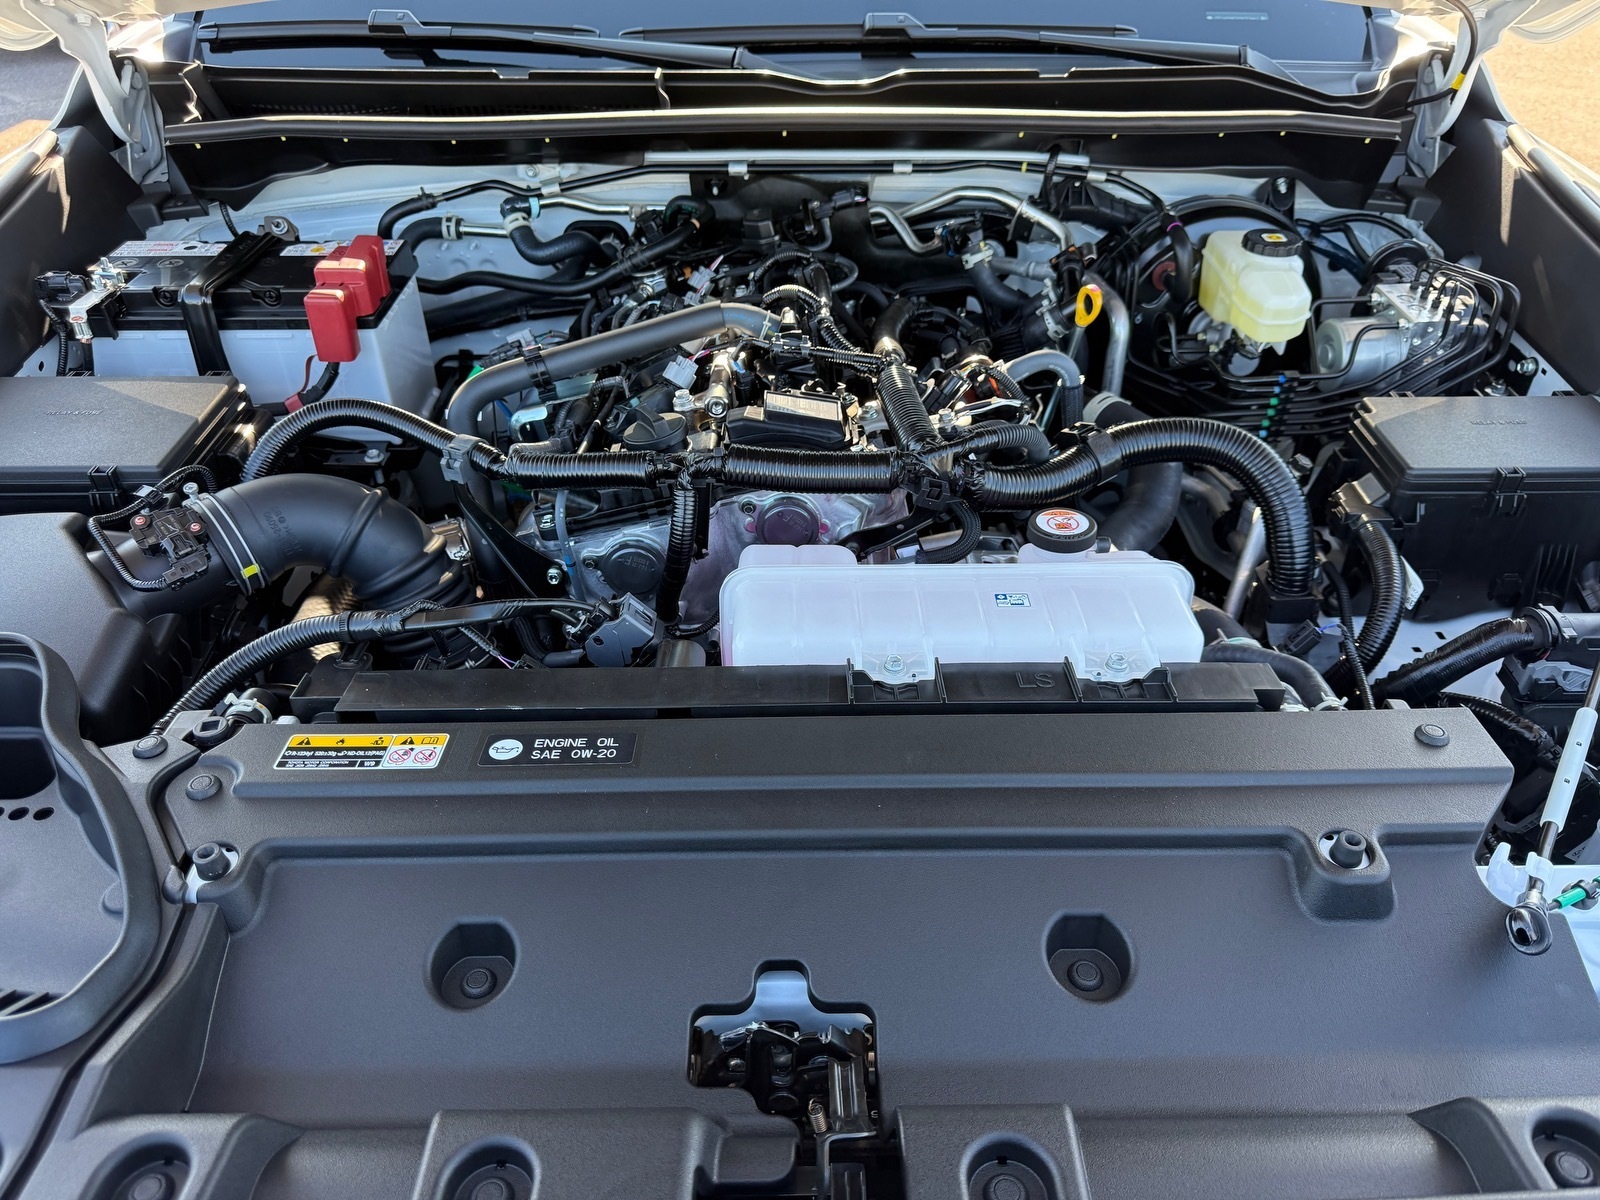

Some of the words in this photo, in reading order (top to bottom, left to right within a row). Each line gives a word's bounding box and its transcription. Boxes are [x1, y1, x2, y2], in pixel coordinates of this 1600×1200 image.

[1015, 671, 1056, 688] LS
[534, 738, 588, 748] ENGINE
[596, 738, 619, 747] OIL
[530, 749, 562, 760] SAE
[571, 749, 617, 759] 0W-20
